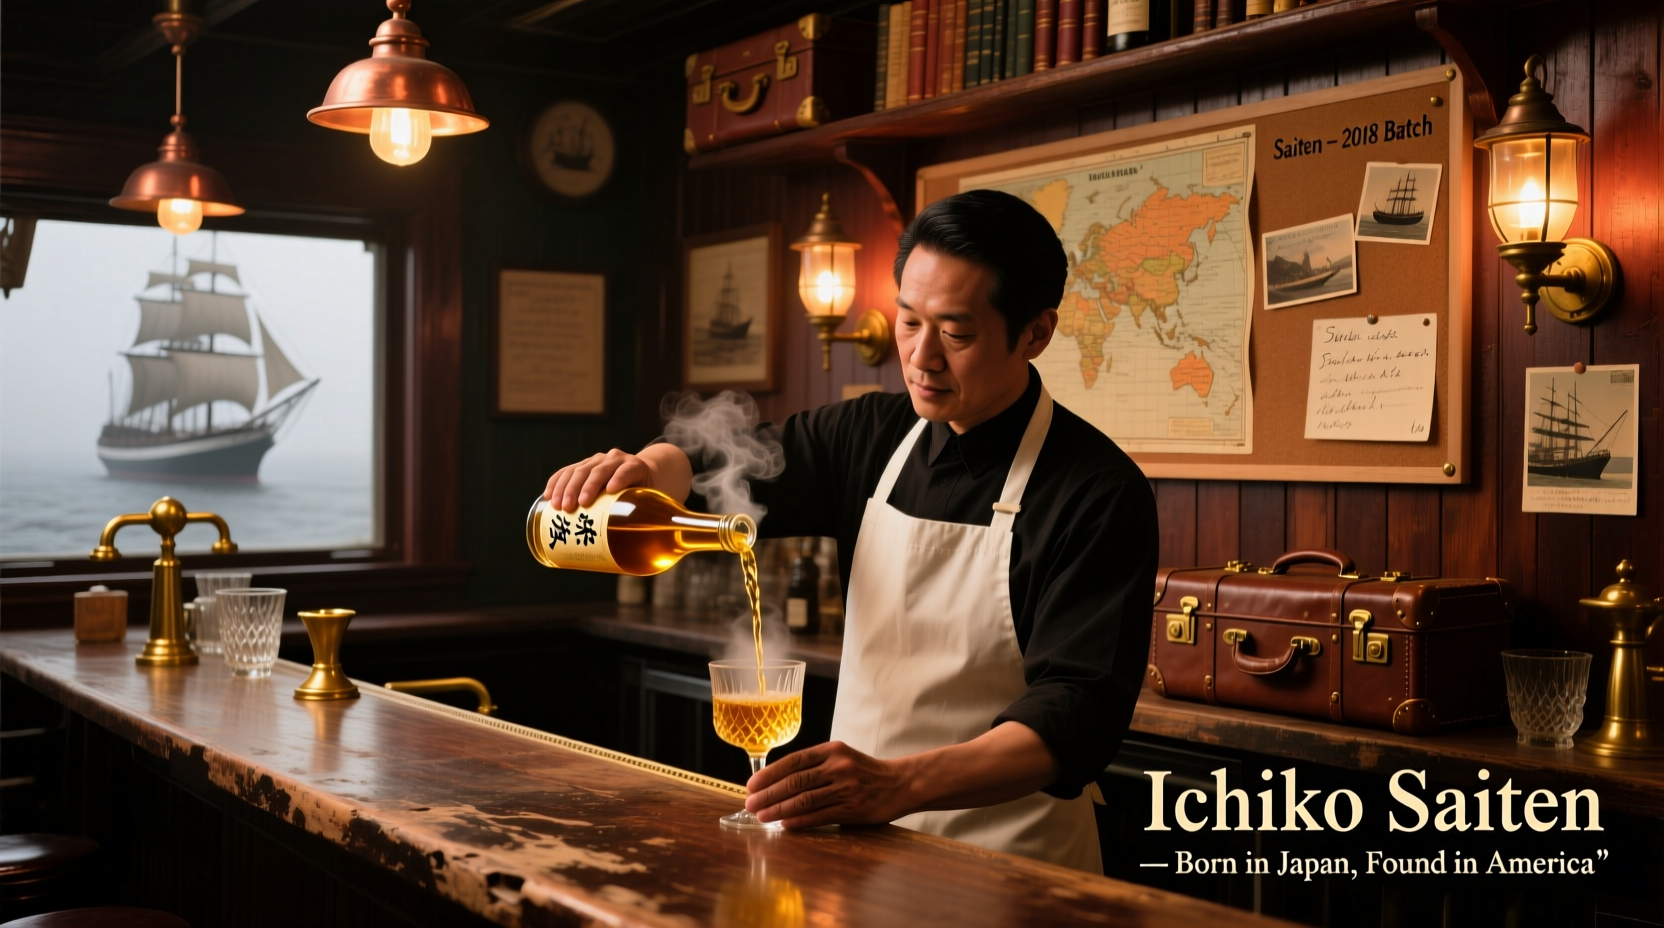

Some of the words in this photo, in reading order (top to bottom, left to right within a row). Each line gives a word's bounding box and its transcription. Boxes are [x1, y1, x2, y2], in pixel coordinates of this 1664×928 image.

[1273, 136, 1323, 160] Saiten
[1341, 122, 1379, 149] 2018
[1383, 113, 1433, 143] Batch
